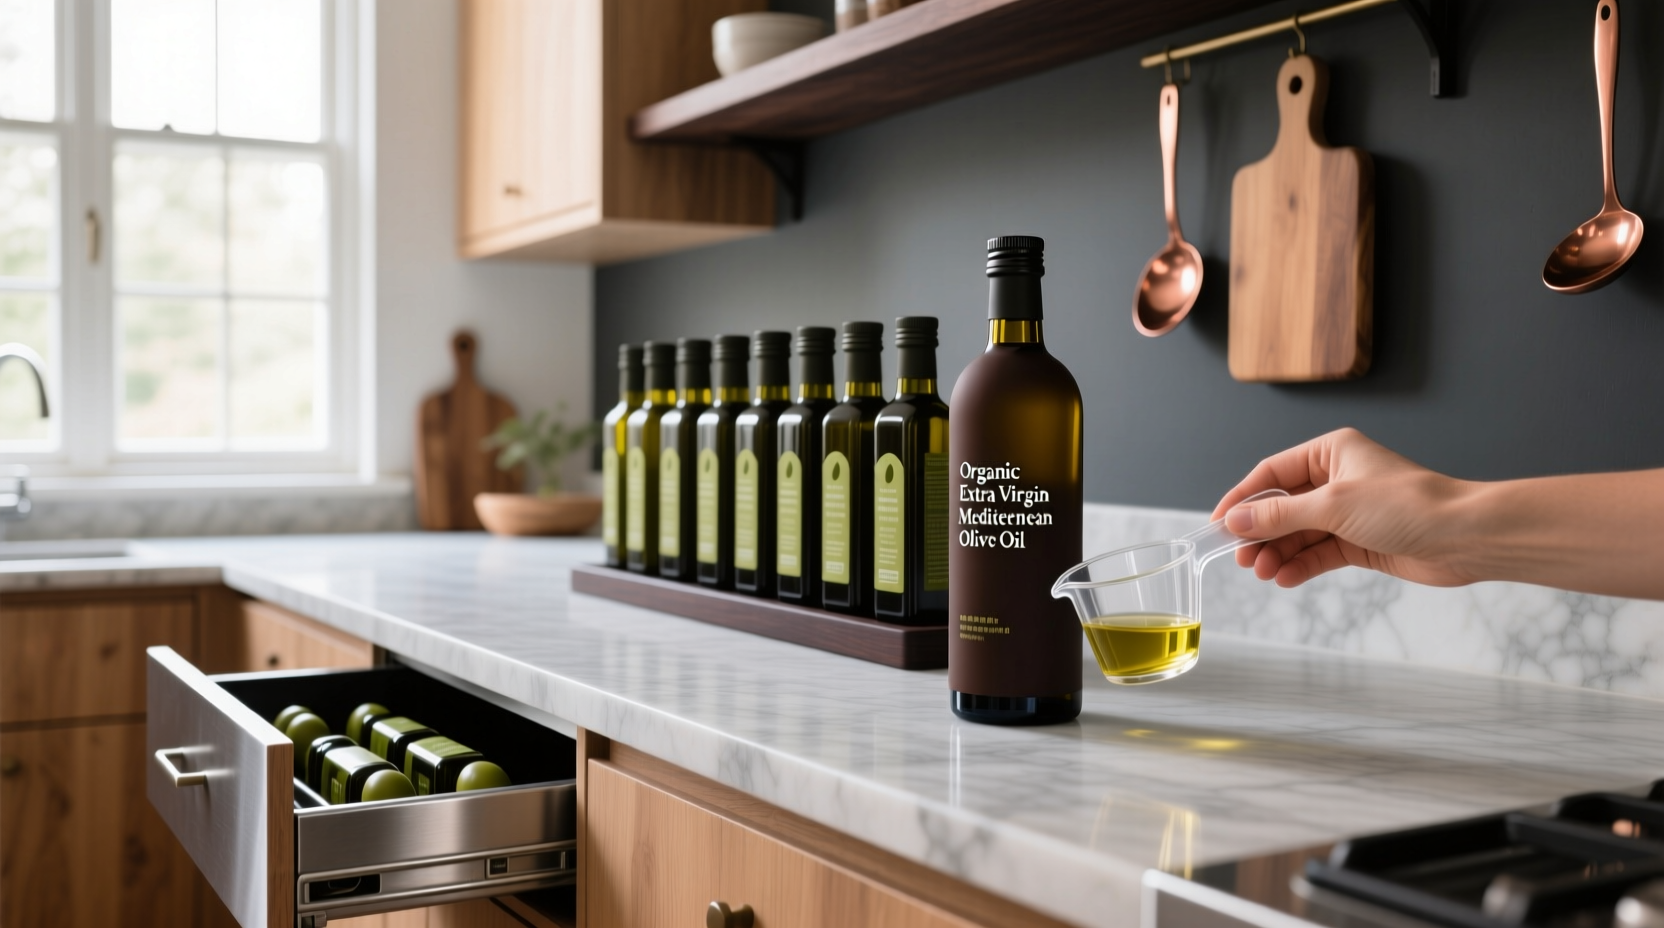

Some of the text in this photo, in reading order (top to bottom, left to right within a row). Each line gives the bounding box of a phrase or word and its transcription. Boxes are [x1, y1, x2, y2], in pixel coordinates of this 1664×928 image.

[960, 461, 1021, 485] Organic
[960, 484, 1050, 508] Extra Virgin
[959, 529, 1026, 549] Olive Oil
